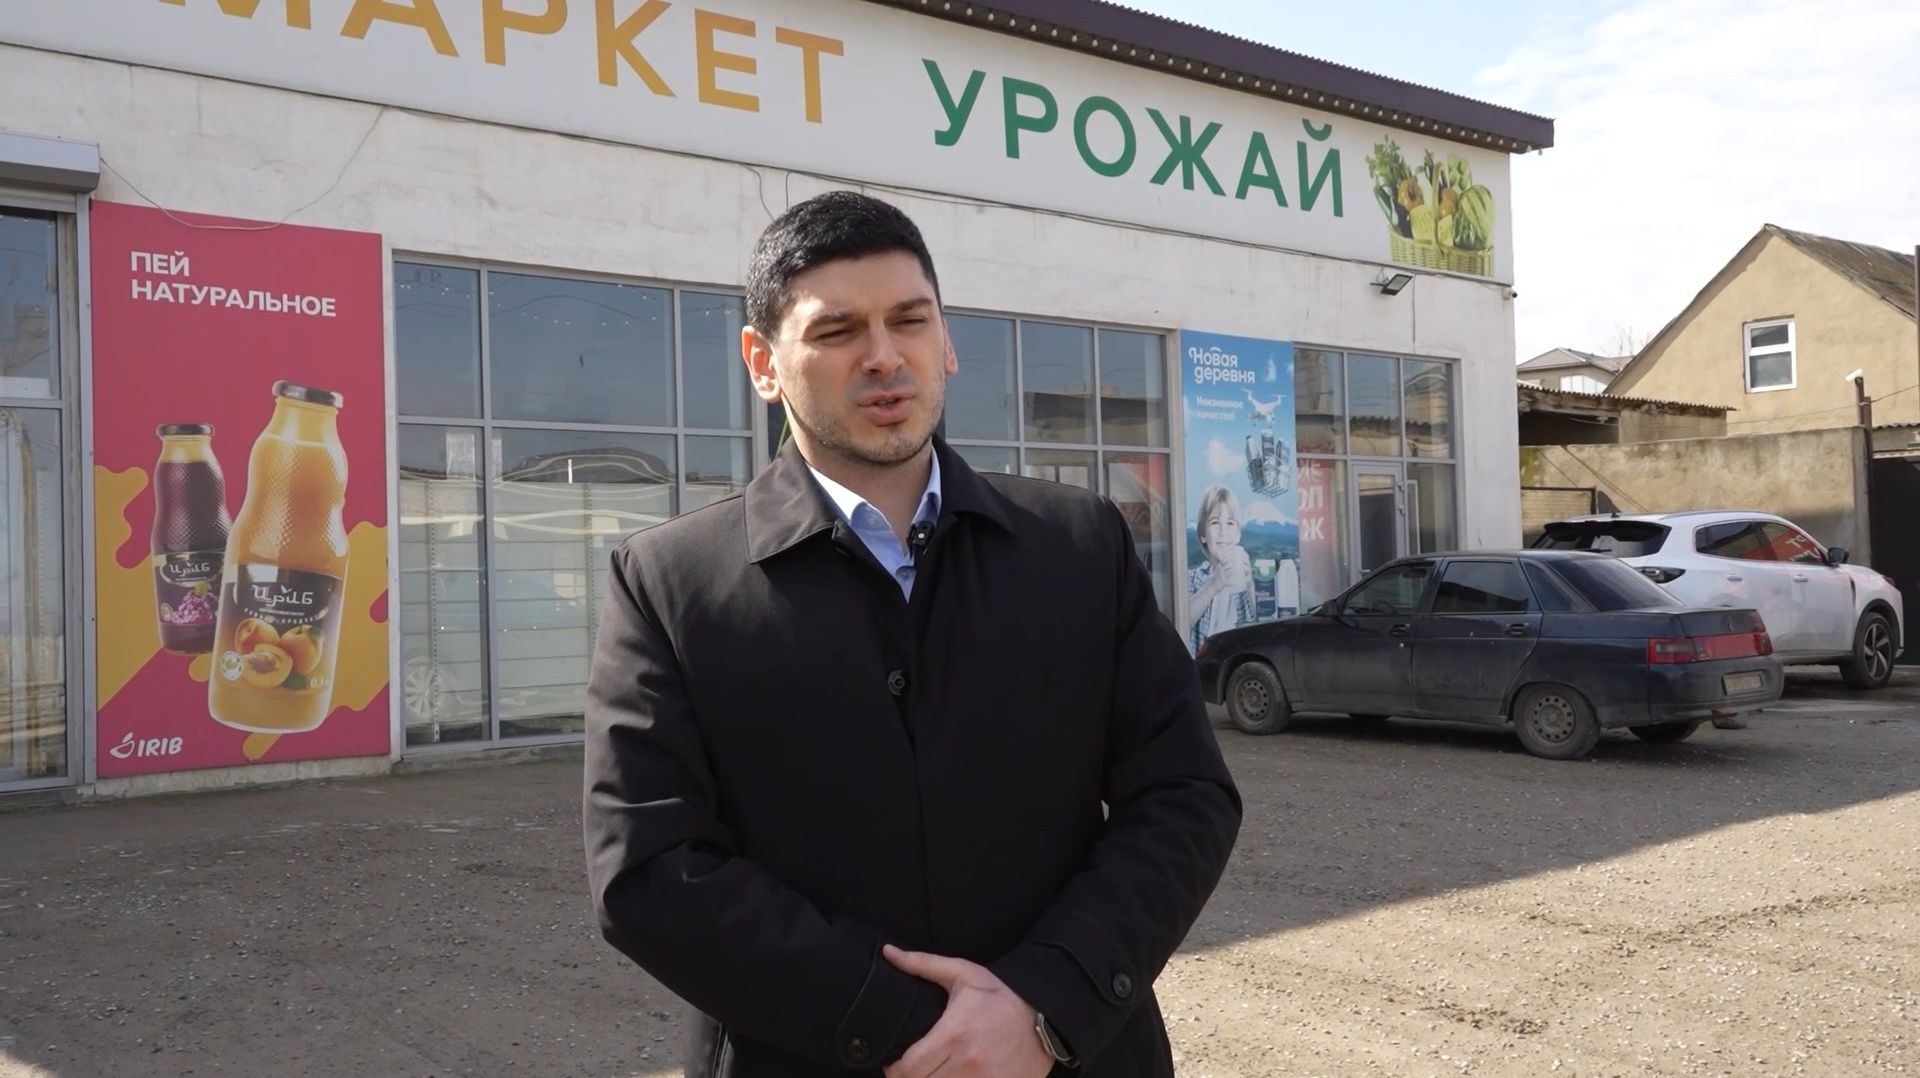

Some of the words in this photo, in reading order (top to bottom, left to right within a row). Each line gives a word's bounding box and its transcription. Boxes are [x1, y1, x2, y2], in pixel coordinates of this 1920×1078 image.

[922, 58, 1344, 218] УРОЖАЙ
[131, 251, 190, 276] ПЕЙ
[131, 279, 337, 317] НАТУРАЛЬНОЕ
[1188, 346, 1238, 368] Новая
[1194, 366, 1255, 385] деревня
[137, 737, 183, 758] IRIB
